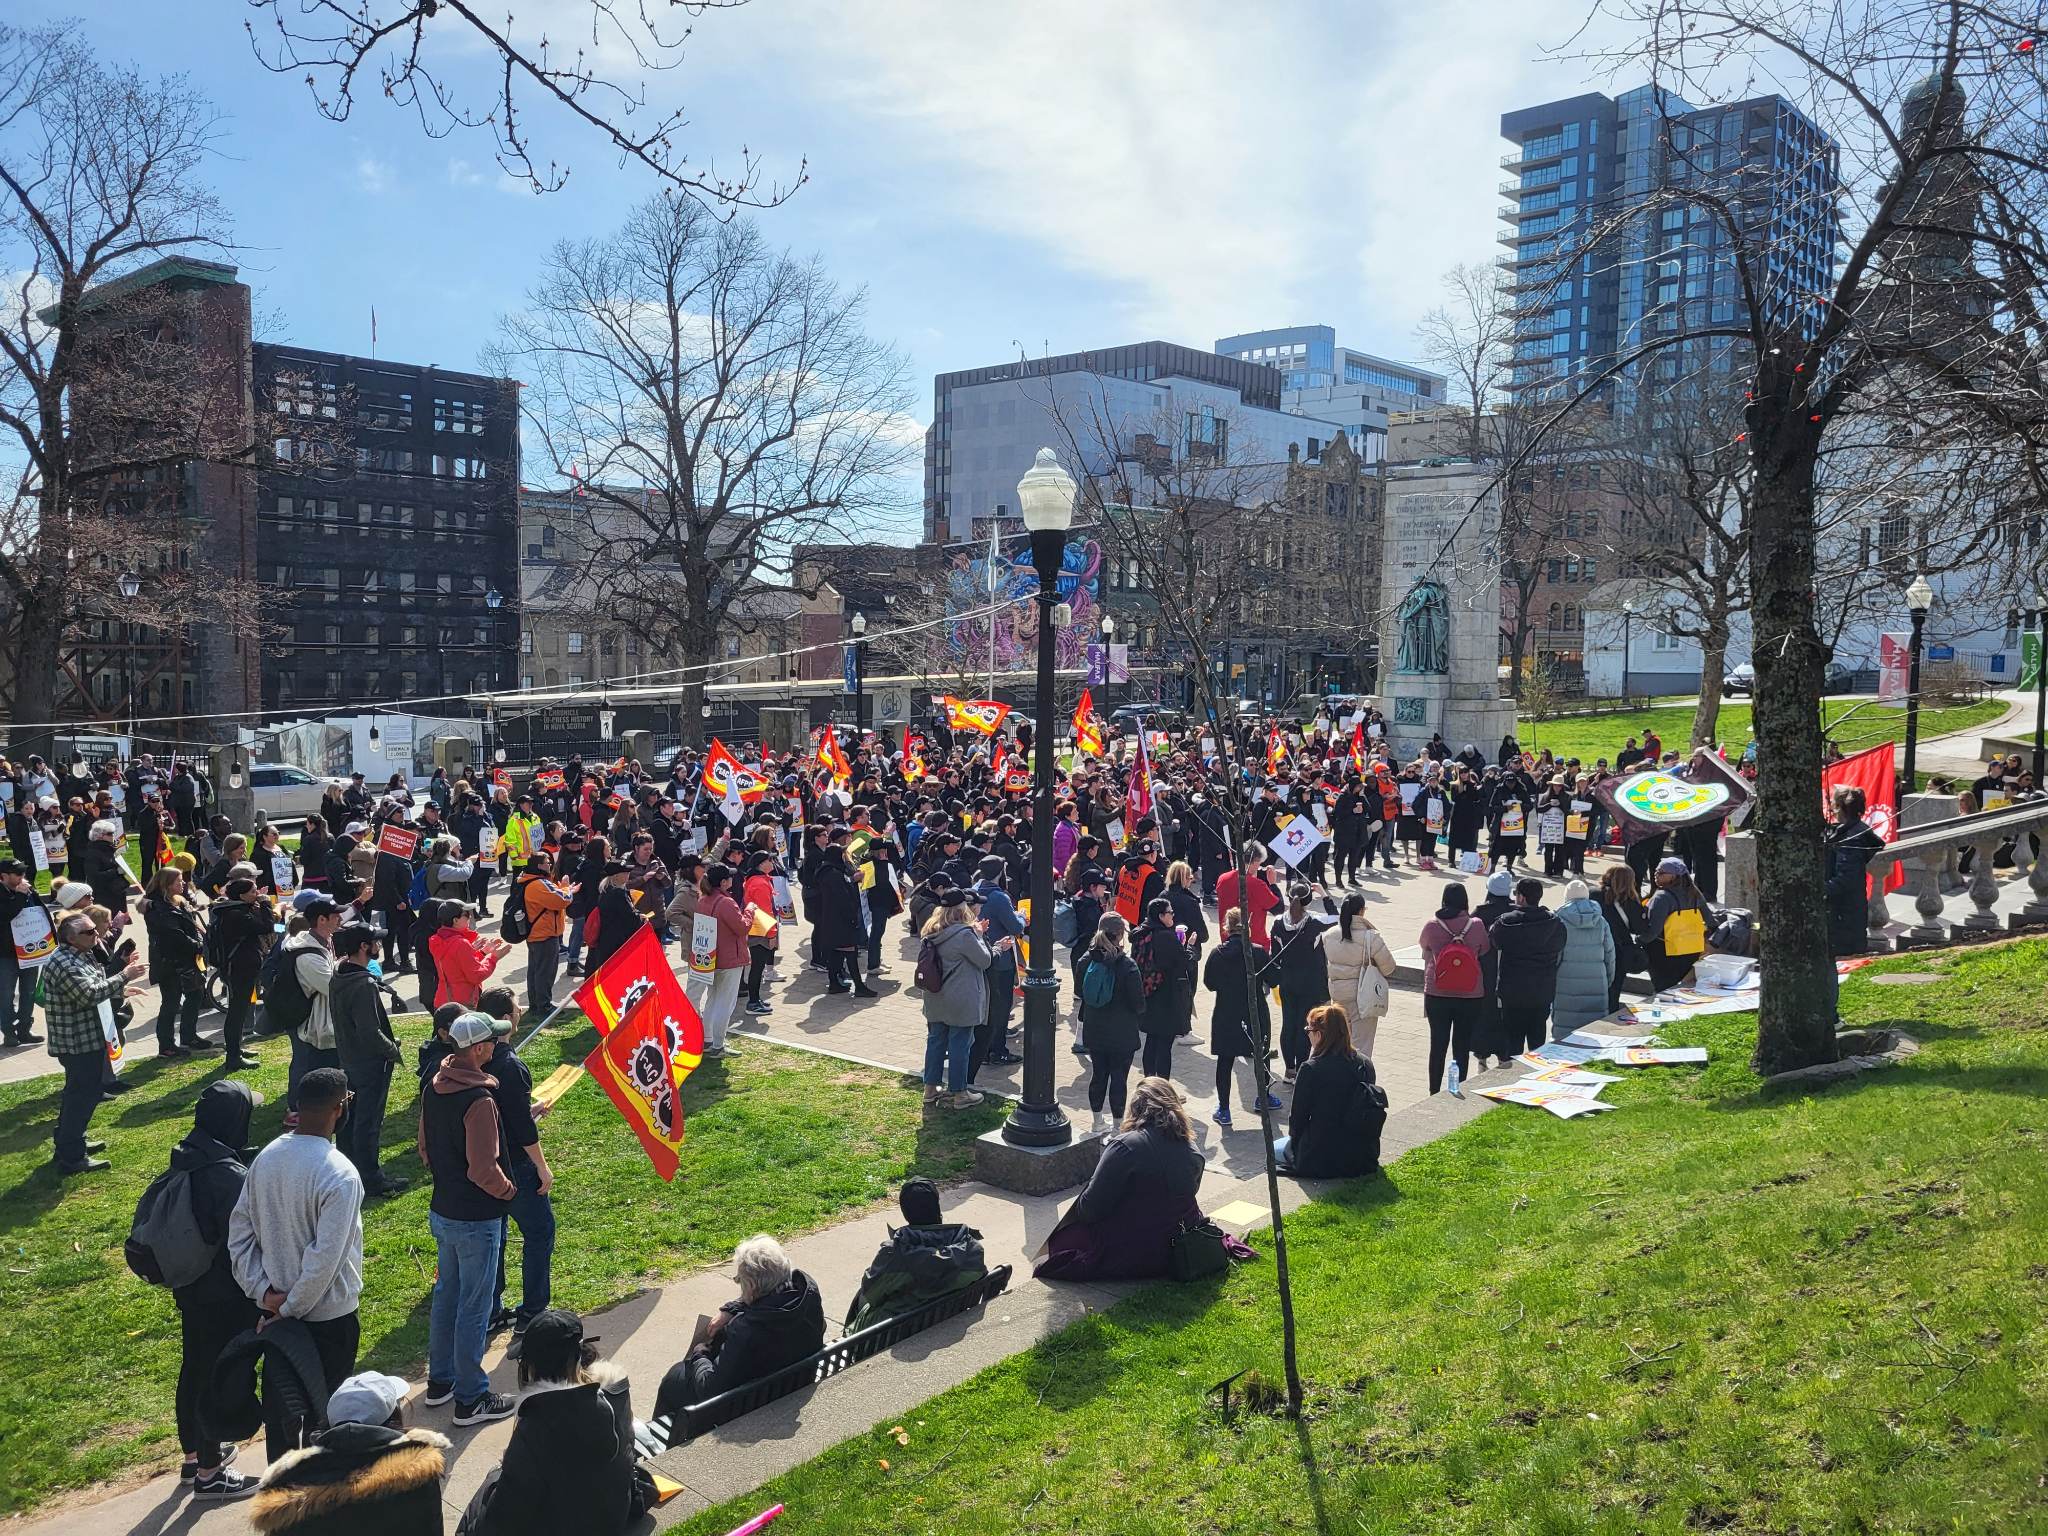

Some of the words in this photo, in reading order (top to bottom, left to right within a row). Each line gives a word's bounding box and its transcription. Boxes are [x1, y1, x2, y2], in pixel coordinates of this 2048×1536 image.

[566, 722, 586, 730] SCOTIA
[715, 763, 730, 779] PSAC
[736, 776, 753, 788] AFPC
[390, 842, 403, 850] TEAM
[695, 935, 709, 947] MILK
